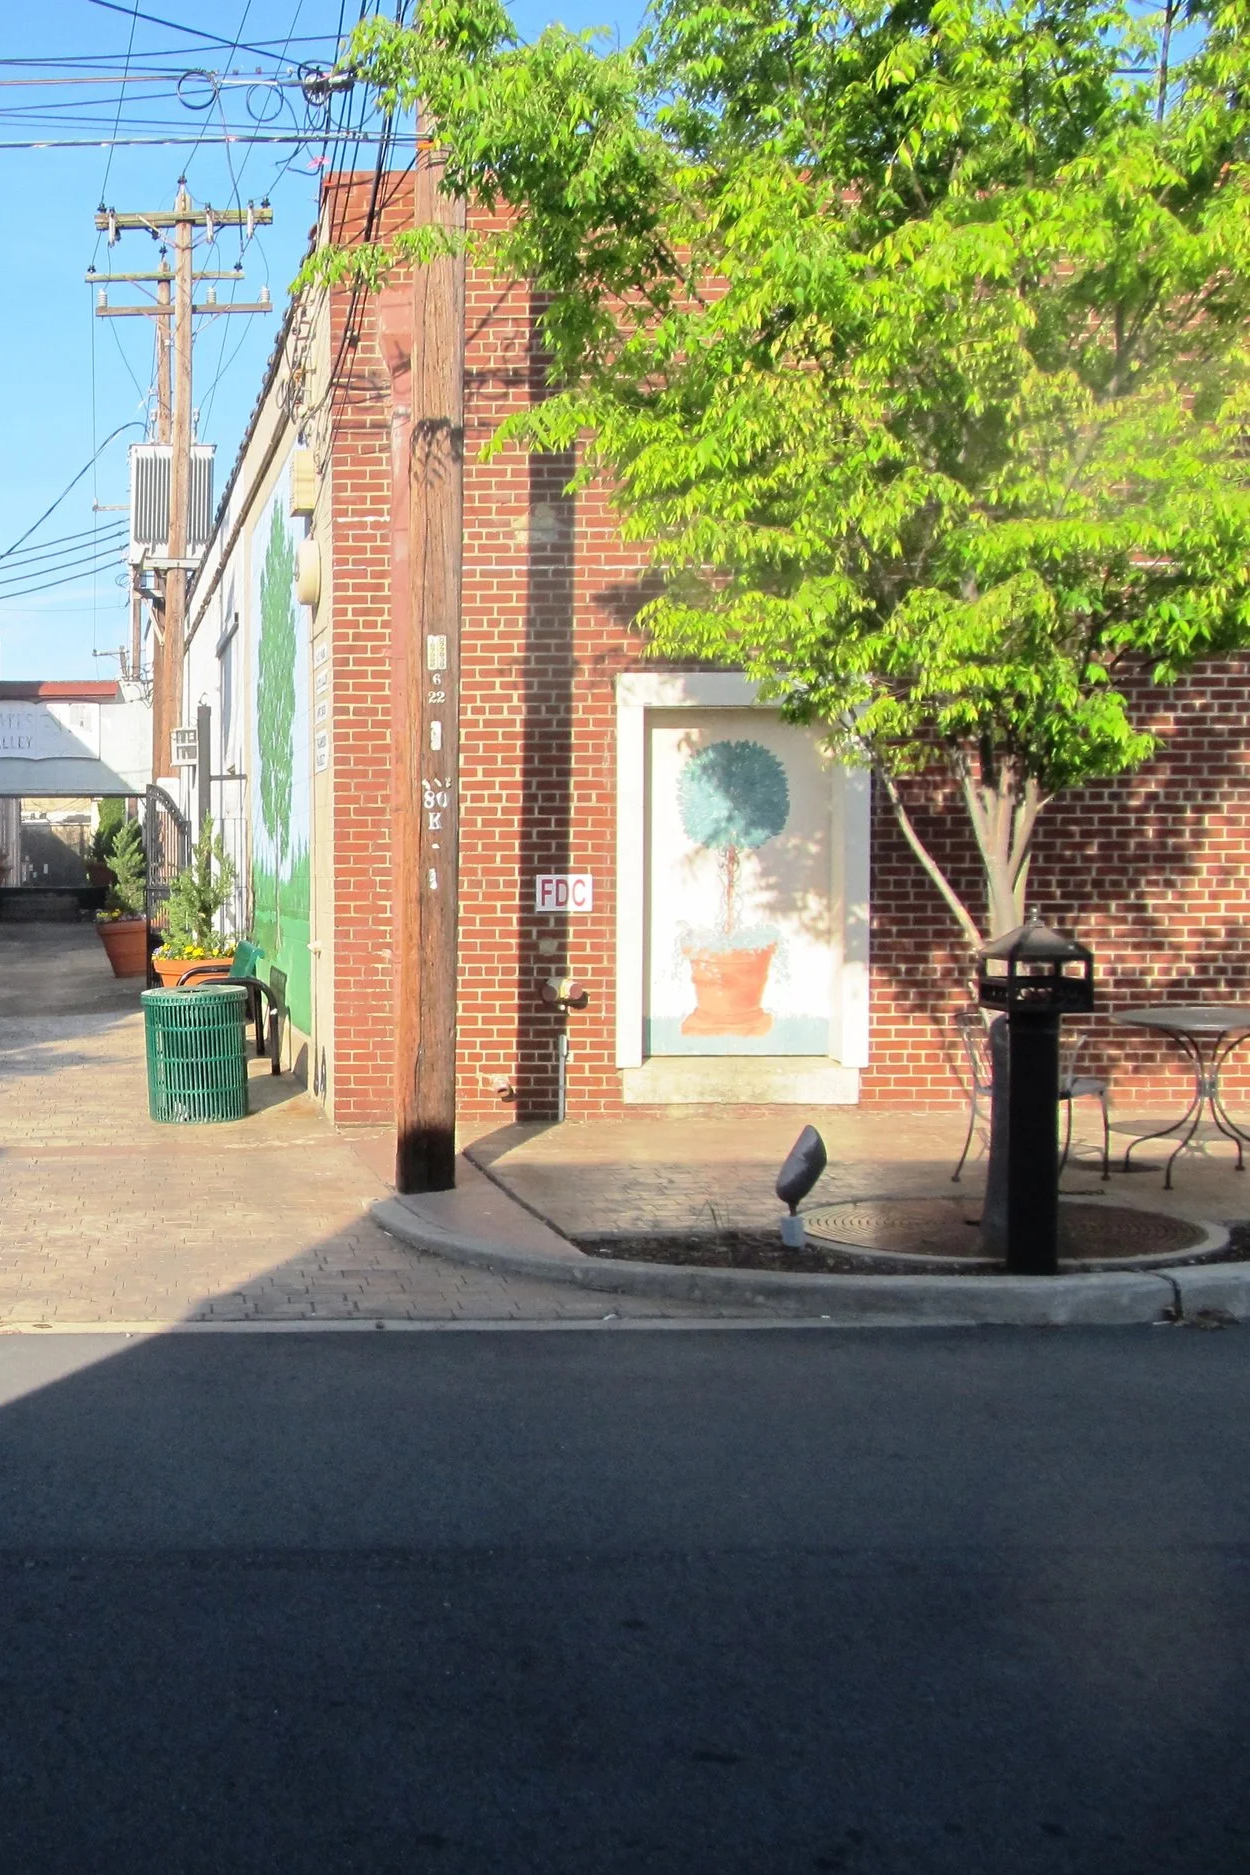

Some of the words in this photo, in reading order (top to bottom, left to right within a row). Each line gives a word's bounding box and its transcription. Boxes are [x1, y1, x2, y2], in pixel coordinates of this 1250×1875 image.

[432, 673, 442, 686] 6
[428, 690, 447, 704] 22
[424, 790, 447, 808] 80
[428, 812, 442, 830] K
[542, 879, 585, 906] FDC
